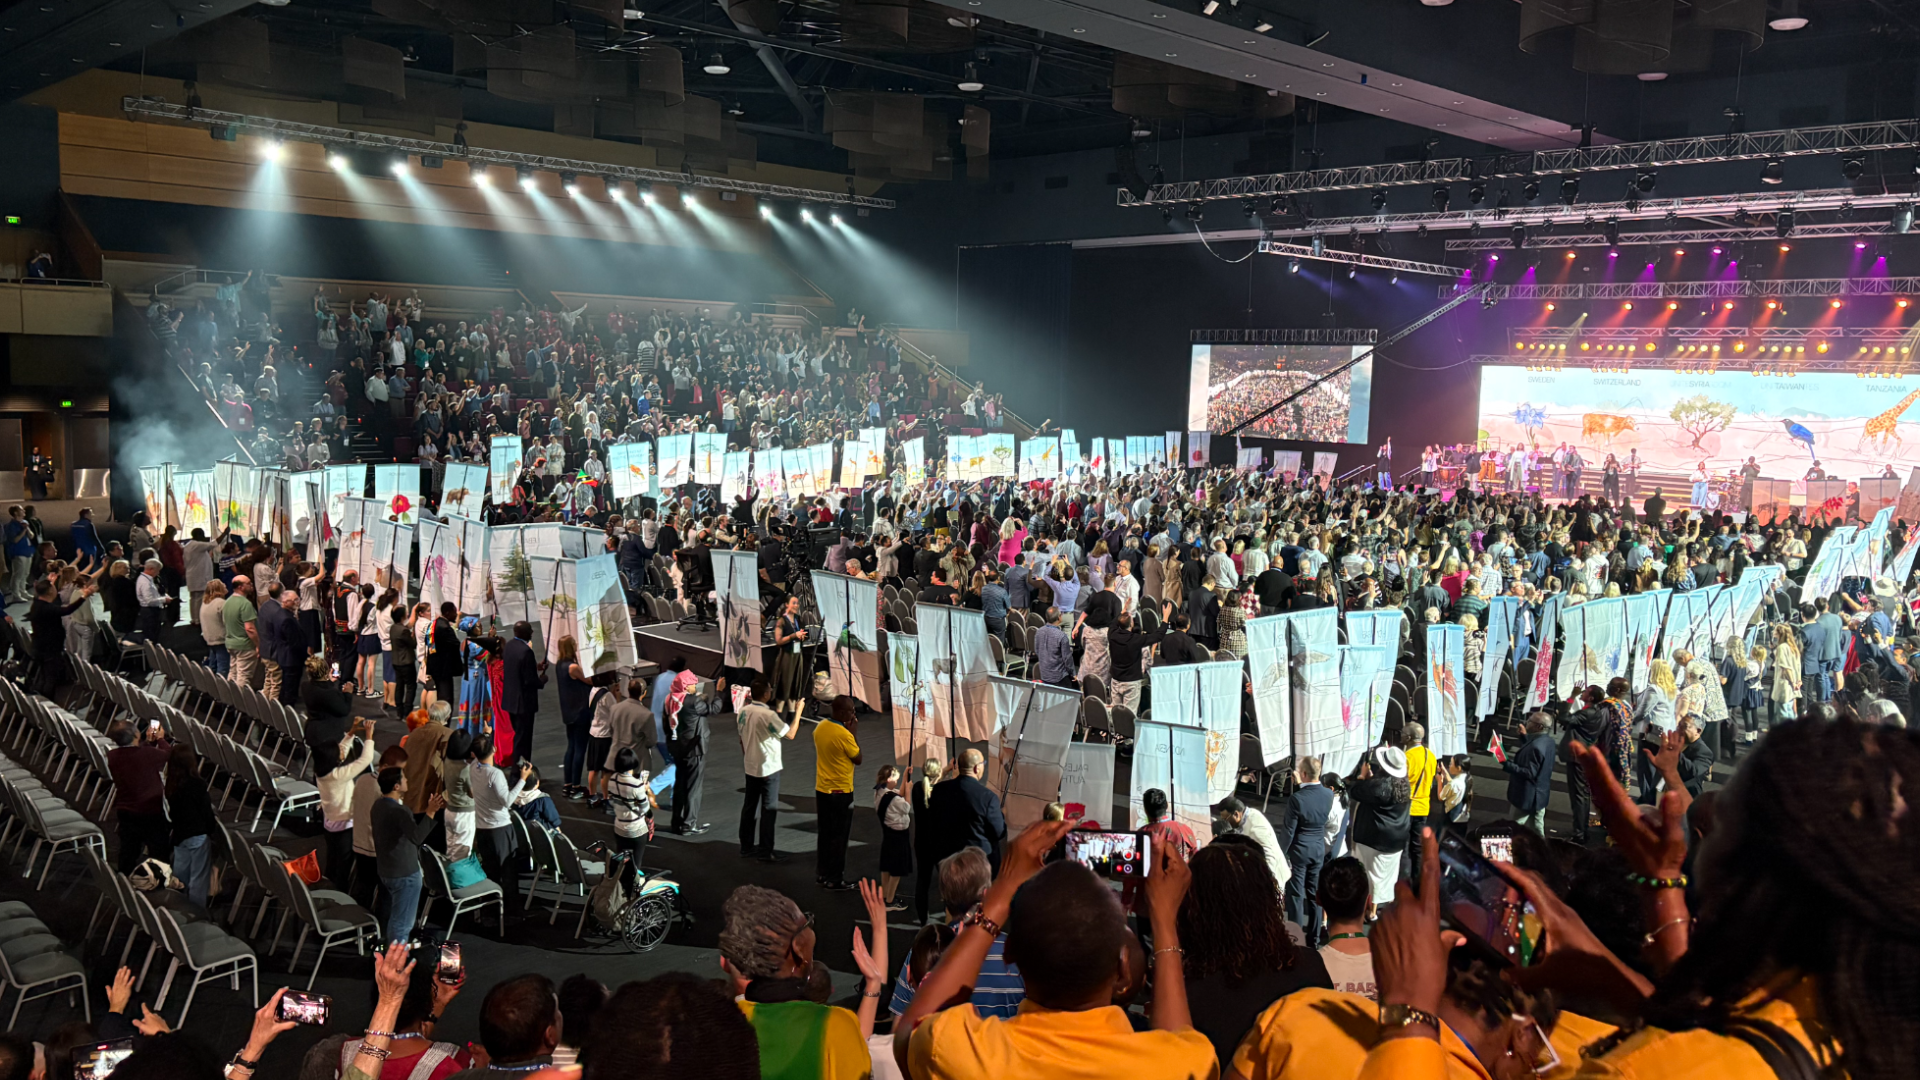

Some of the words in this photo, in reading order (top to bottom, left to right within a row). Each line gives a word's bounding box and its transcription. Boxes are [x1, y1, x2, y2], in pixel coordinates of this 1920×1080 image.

[1527, 376, 1556, 384] SWEDEN
[1593, 378, 1642, 387] SWITZERLAND
[1689, 380, 1711, 388] SYRIA
[1774, 382, 1805, 391] TAIWAN
[1865, 384, 1908, 393] TANZANIA
